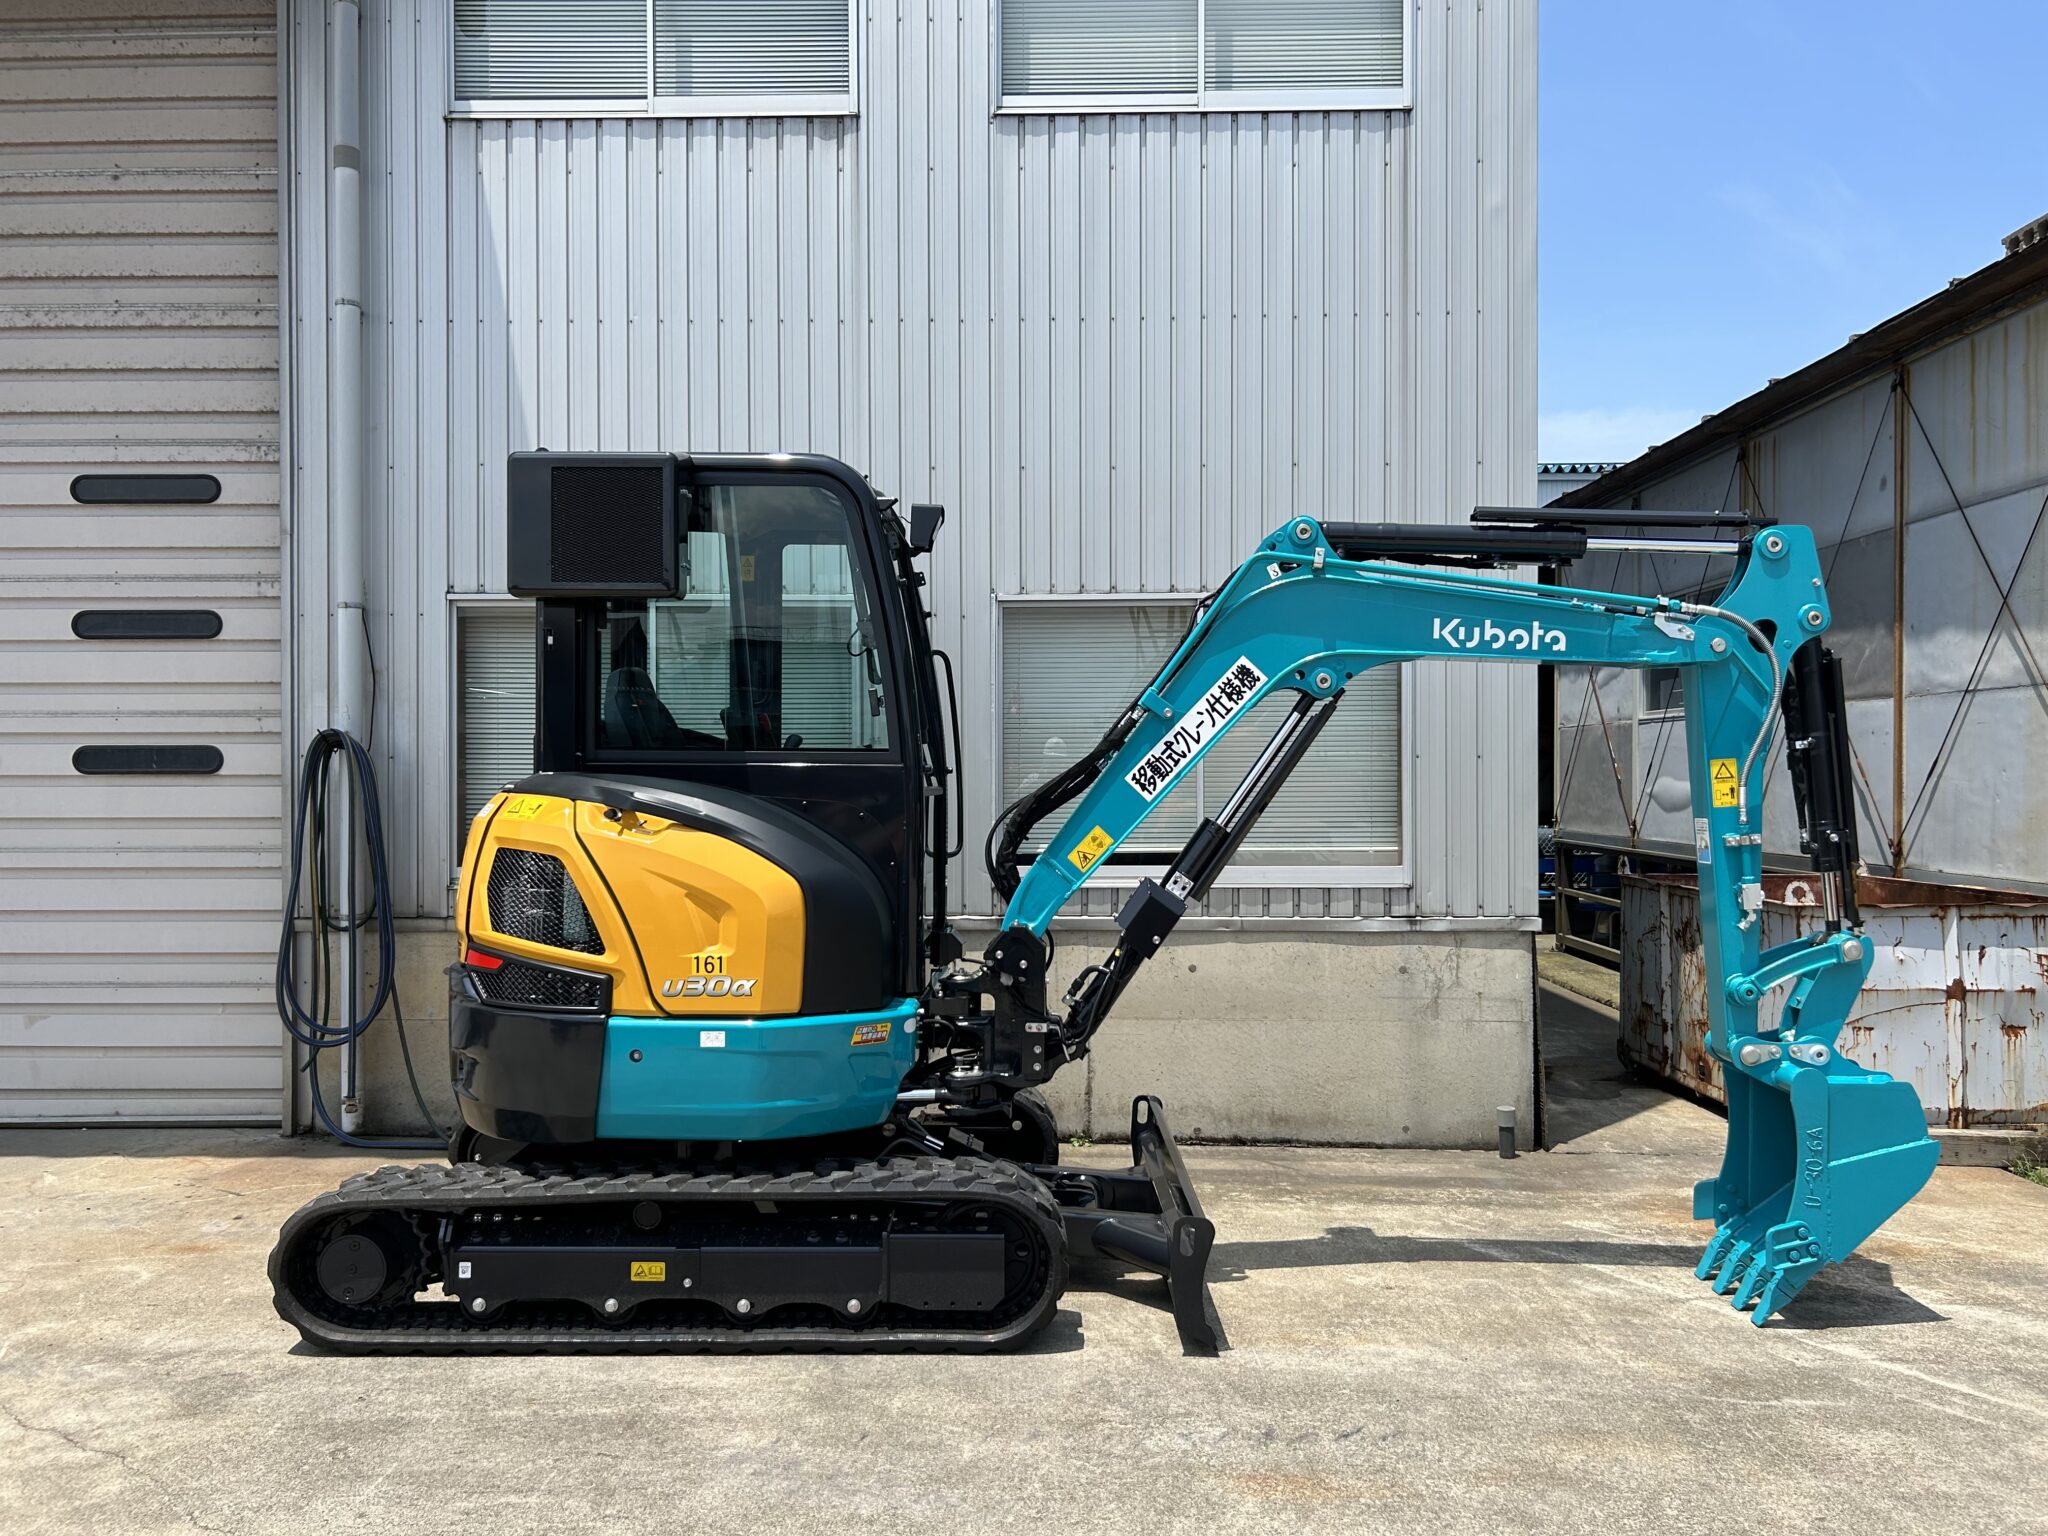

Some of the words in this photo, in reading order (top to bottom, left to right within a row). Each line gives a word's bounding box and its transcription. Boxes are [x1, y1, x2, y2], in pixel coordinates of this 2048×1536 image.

[1432, 617, 1567, 652] Kubota
[1131, 664, 1261, 795] 移動式クレーン仕様機
[693, 955, 723, 974] 161
